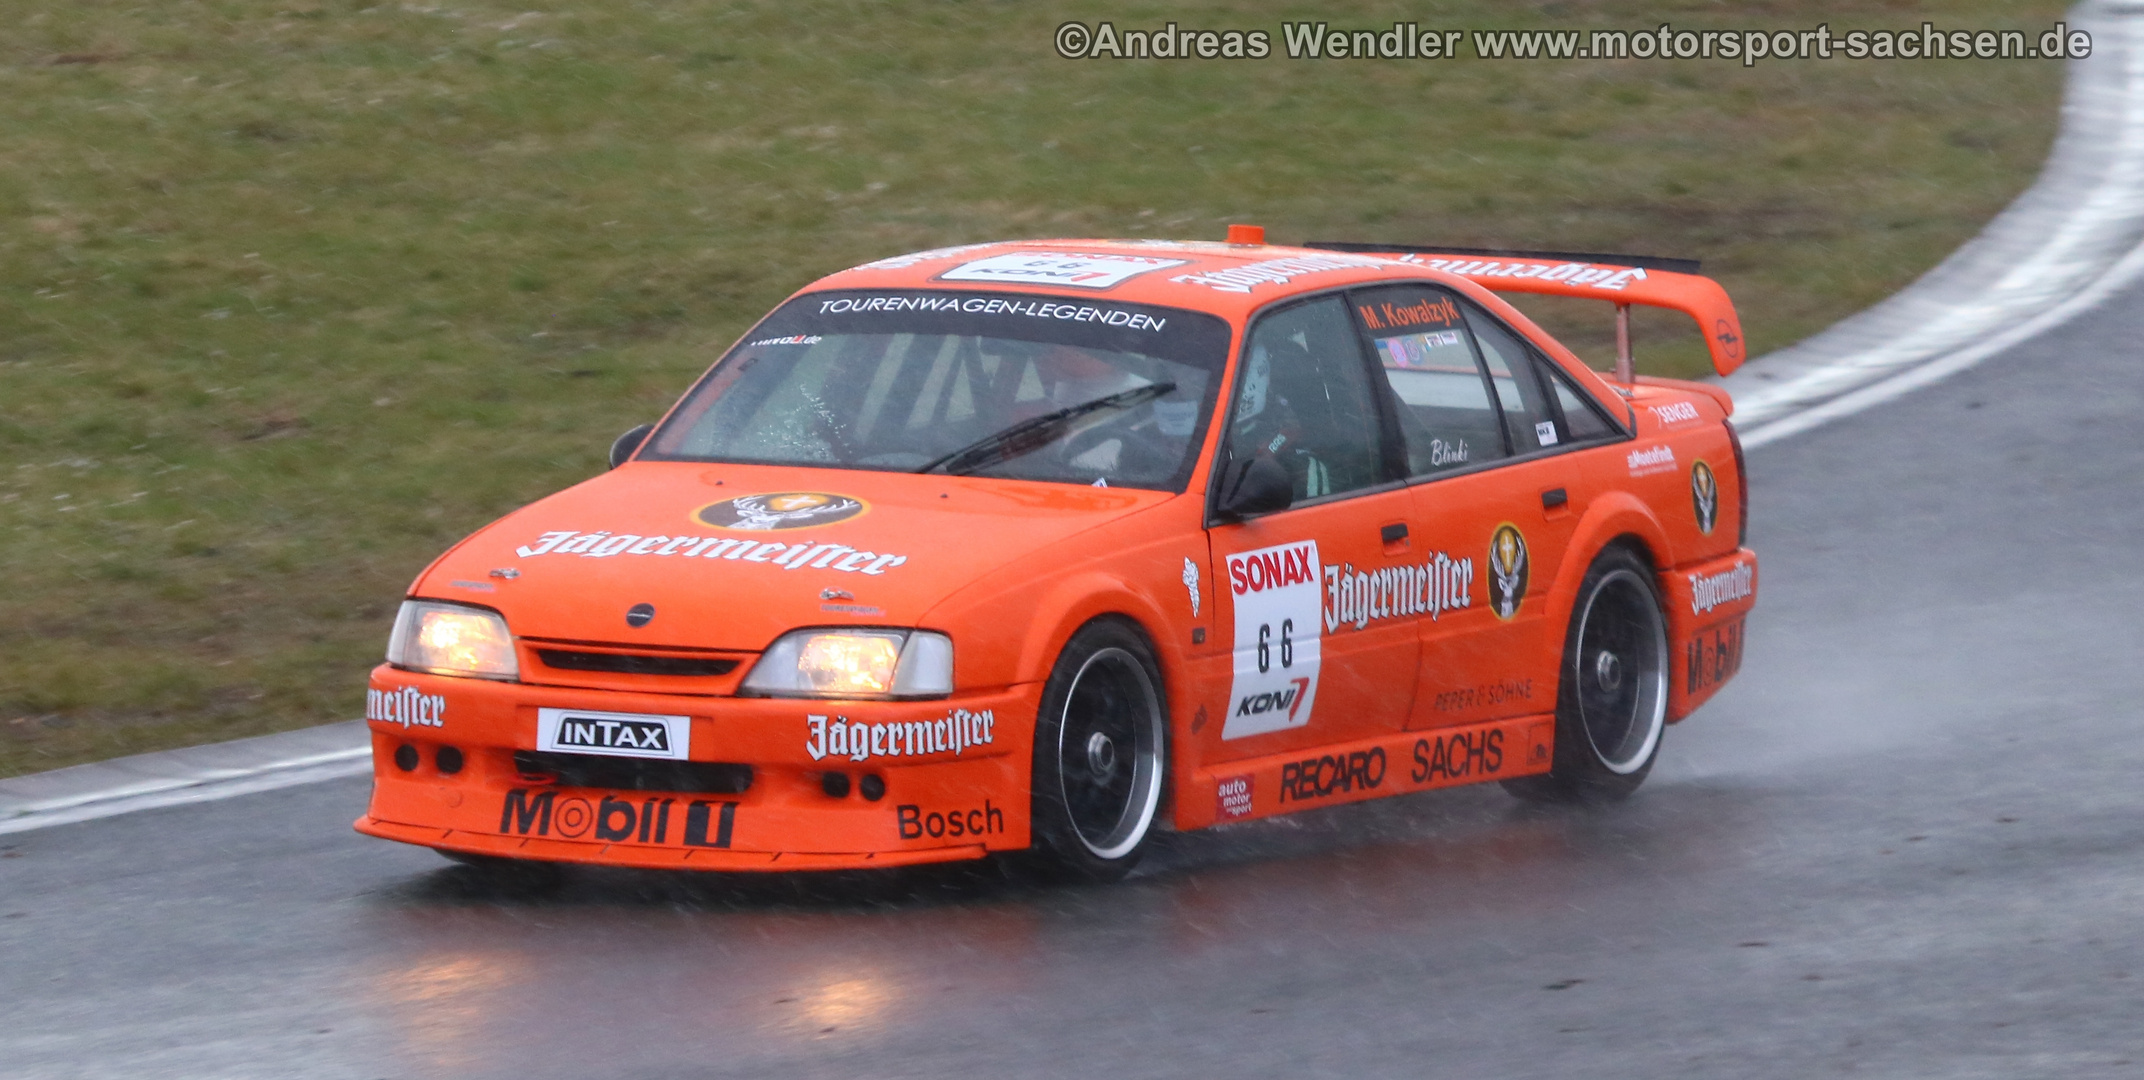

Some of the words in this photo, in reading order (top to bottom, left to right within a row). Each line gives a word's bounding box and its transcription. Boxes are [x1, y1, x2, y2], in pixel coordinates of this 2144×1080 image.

[819, 296, 1166, 332] TOURENWAGEN-LEGENDEN
[1359, 305, 1386, 329] M.
[1381, 296, 1460, 327] Kowalzyk
[1657, 402, 1698, 423] SENGER
[1431, 438, 1468, 466] Blinki
[1230, 546, 1314, 596] SONAX
[1258, 619, 1293, 673] 66
[1236, 692, 1293, 717] KONI
[564, 720, 662, 750] INTAX
[1411, 729, 1504, 783] SACHS
[1218, 779, 1247, 797] auto
[1279, 746, 1386, 803] RECARO
[500, 788, 674, 844] Mobil
[1223, 793, 1250, 807] motor
[897, 801, 1004, 840] Bosch
